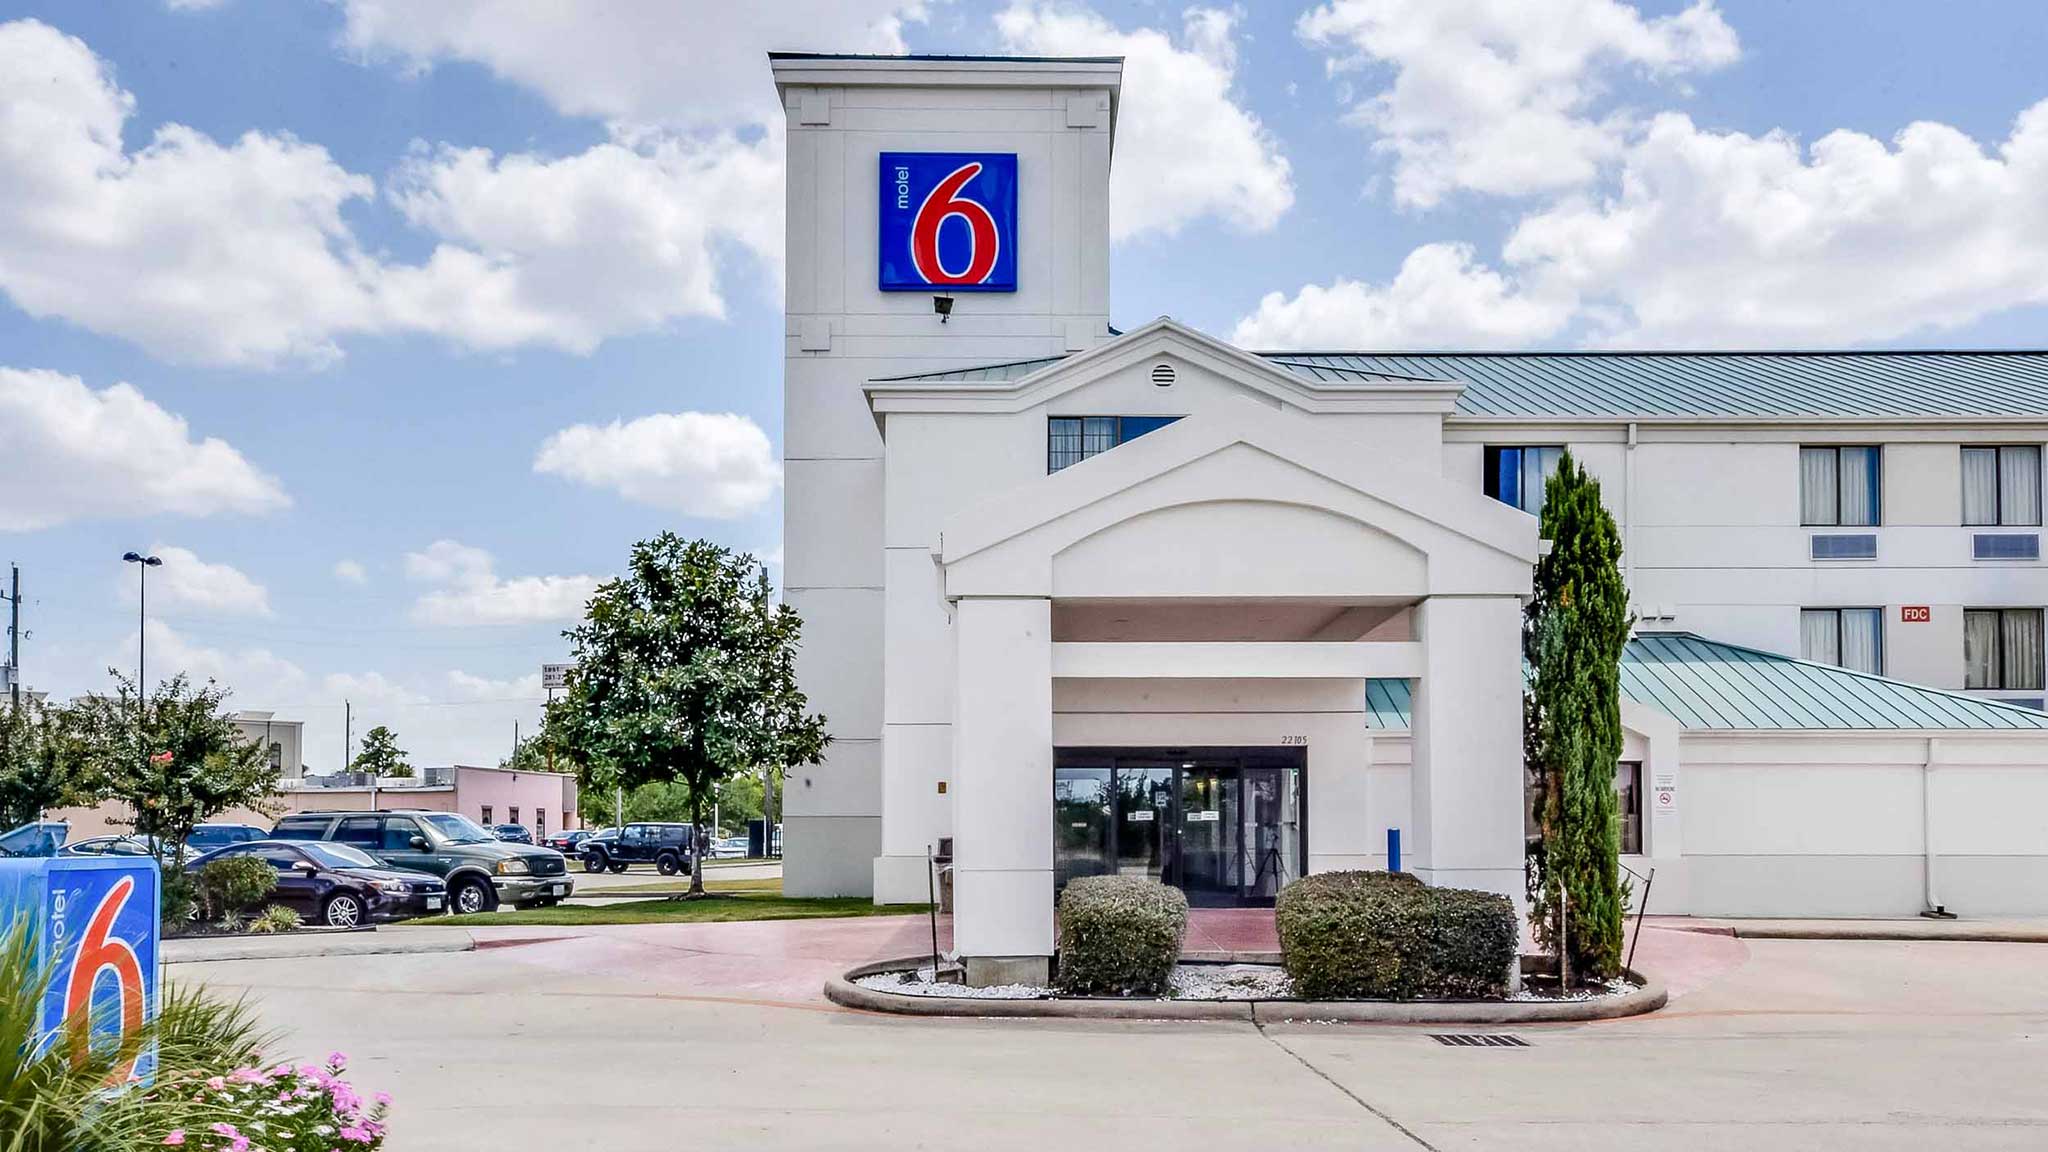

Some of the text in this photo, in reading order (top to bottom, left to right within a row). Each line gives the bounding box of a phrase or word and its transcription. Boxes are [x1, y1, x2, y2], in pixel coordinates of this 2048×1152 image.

[895, 166, 909, 209] motel
[911, 162, 1000, 284] 6
[1904, 608, 1928, 620] FDC
[1281, 735, 1308, 745] 22105
[51, 889, 66, 964] motel
[64, 874, 146, 1088] 6
